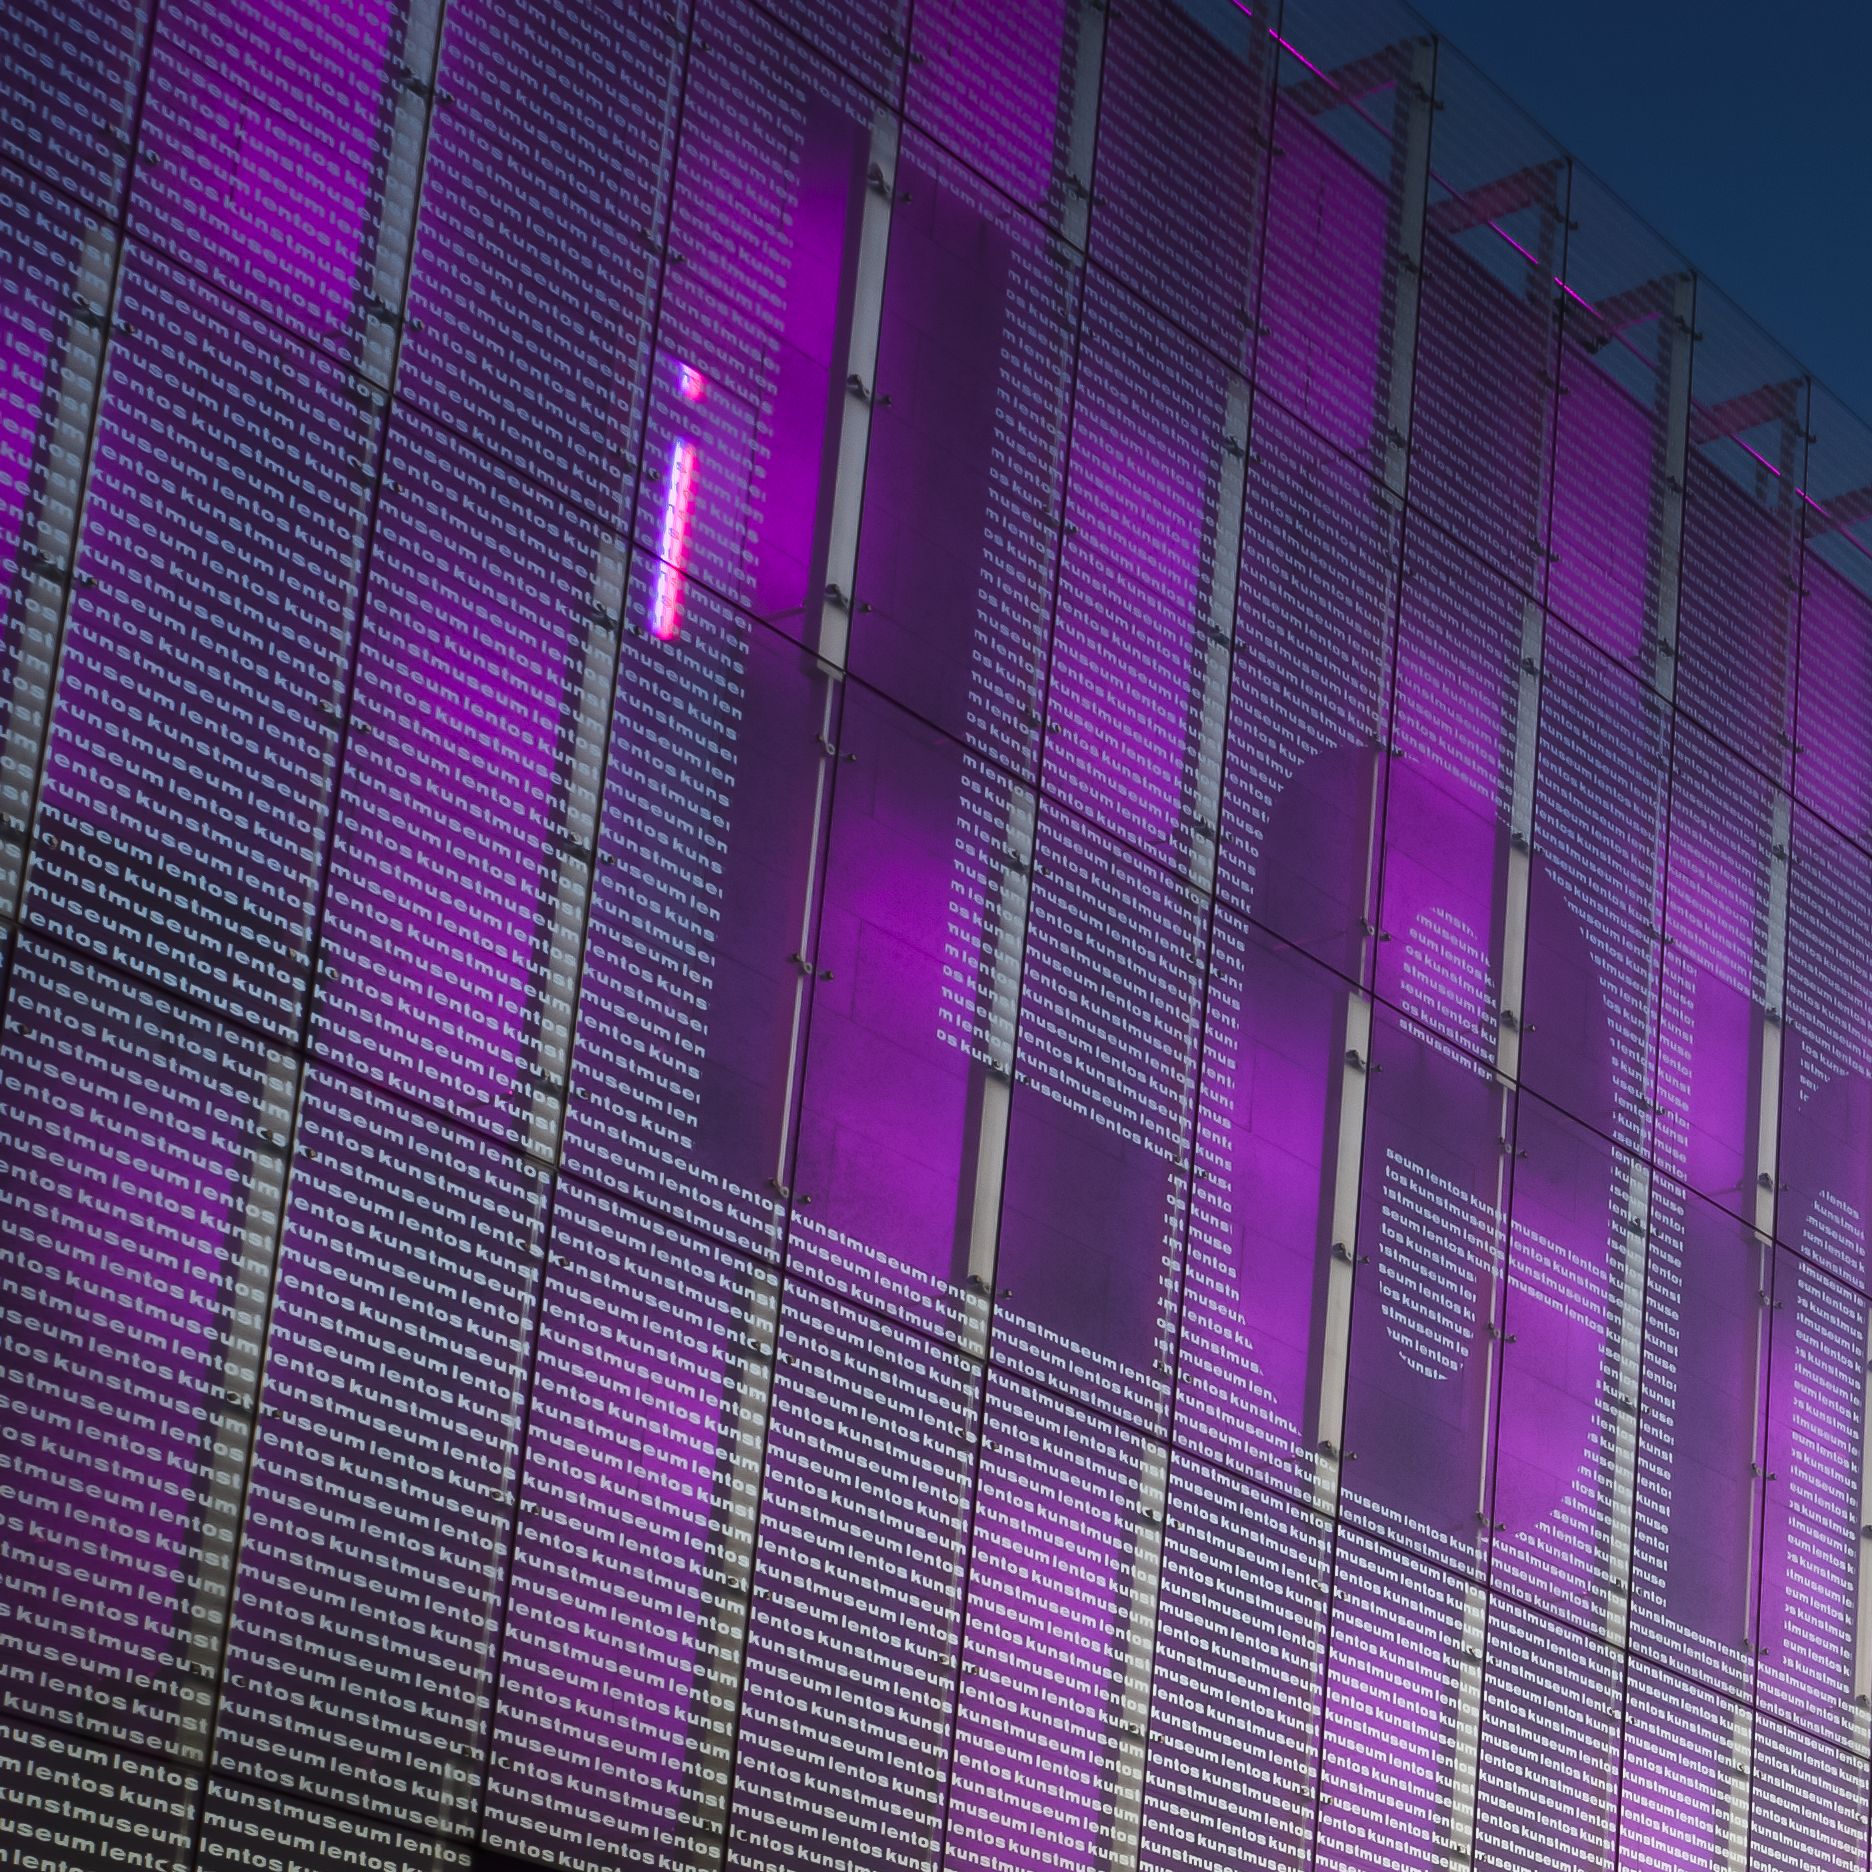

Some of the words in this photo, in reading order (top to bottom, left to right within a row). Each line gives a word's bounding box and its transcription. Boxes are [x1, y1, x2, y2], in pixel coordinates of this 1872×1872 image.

[332, 860, 433, 918] museum
[438, 908, 507, 953] lentos
[511, 942, 572, 983] kunst
[335, 833, 502, 925] kunstmuseum
[506, 914, 574, 959] lentos
[329, 883, 403, 931] lentos
[407, 919, 569, 1007] kunstmuseum
[277, 1269, 355, 1313] lentos
[359, 1301, 527, 1379] kunstmuseum
[281, 1246, 386, 1299] museum
[391, 1287, 463, 1329] lentos
[467, 1317, 529, 1355] kunst
[274, 1295, 449, 1376] kunstmuseum
[453, 1364, 524, 1404] lentos
[539, 1324, 696, 1397] kunstmuseum
[699, 1386, 763, 1423] lentos
[542, 1299, 611, 1340] lentos
[615, 1328, 765, 1400] kunstmuseum
[536, 1351, 631, 1397] museum
[635, 1386, 701, 1424] lentos
[704, 1413, 761, 1447] kunst
[246, 1506, 326, 1547] lentos
[330, 1534, 501, 1604] kunstmuseum
[249, 1482, 357, 1530] museum
[362, 1518, 436, 1556] lentos
[440, 1544, 504, 1579] kunst
[242, 1533, 422, 1605] kunstmuseum
[426, 1593, 498, 1630] lentos
[511, 1574, 607, 1618] museum
[612, 1606, 678, 1641] lentos
[682, 1629, 740, 1661] kunst
[514, 1547, 674, 1614] kunstmuseum
[677, 1602, 742, 1637] lentos
[508, 1597, 579, 1634] lentos
[583, 1622, 737, 1686] kunstmuseum
[203, 1814, 314, 1854] museum
[207, 1784, 391, 1845] kunstmuseum
[395, 1831, 470, 1865] lentos
[482, 1828, 554, 1863] lentos
[485, 1805, 583, 1844] museum
[588, 1832, 656, 1865] lentos
[488, 1776, 651, 1837] kunstmuseum
[654, 1825, 720, 1857] lentos
